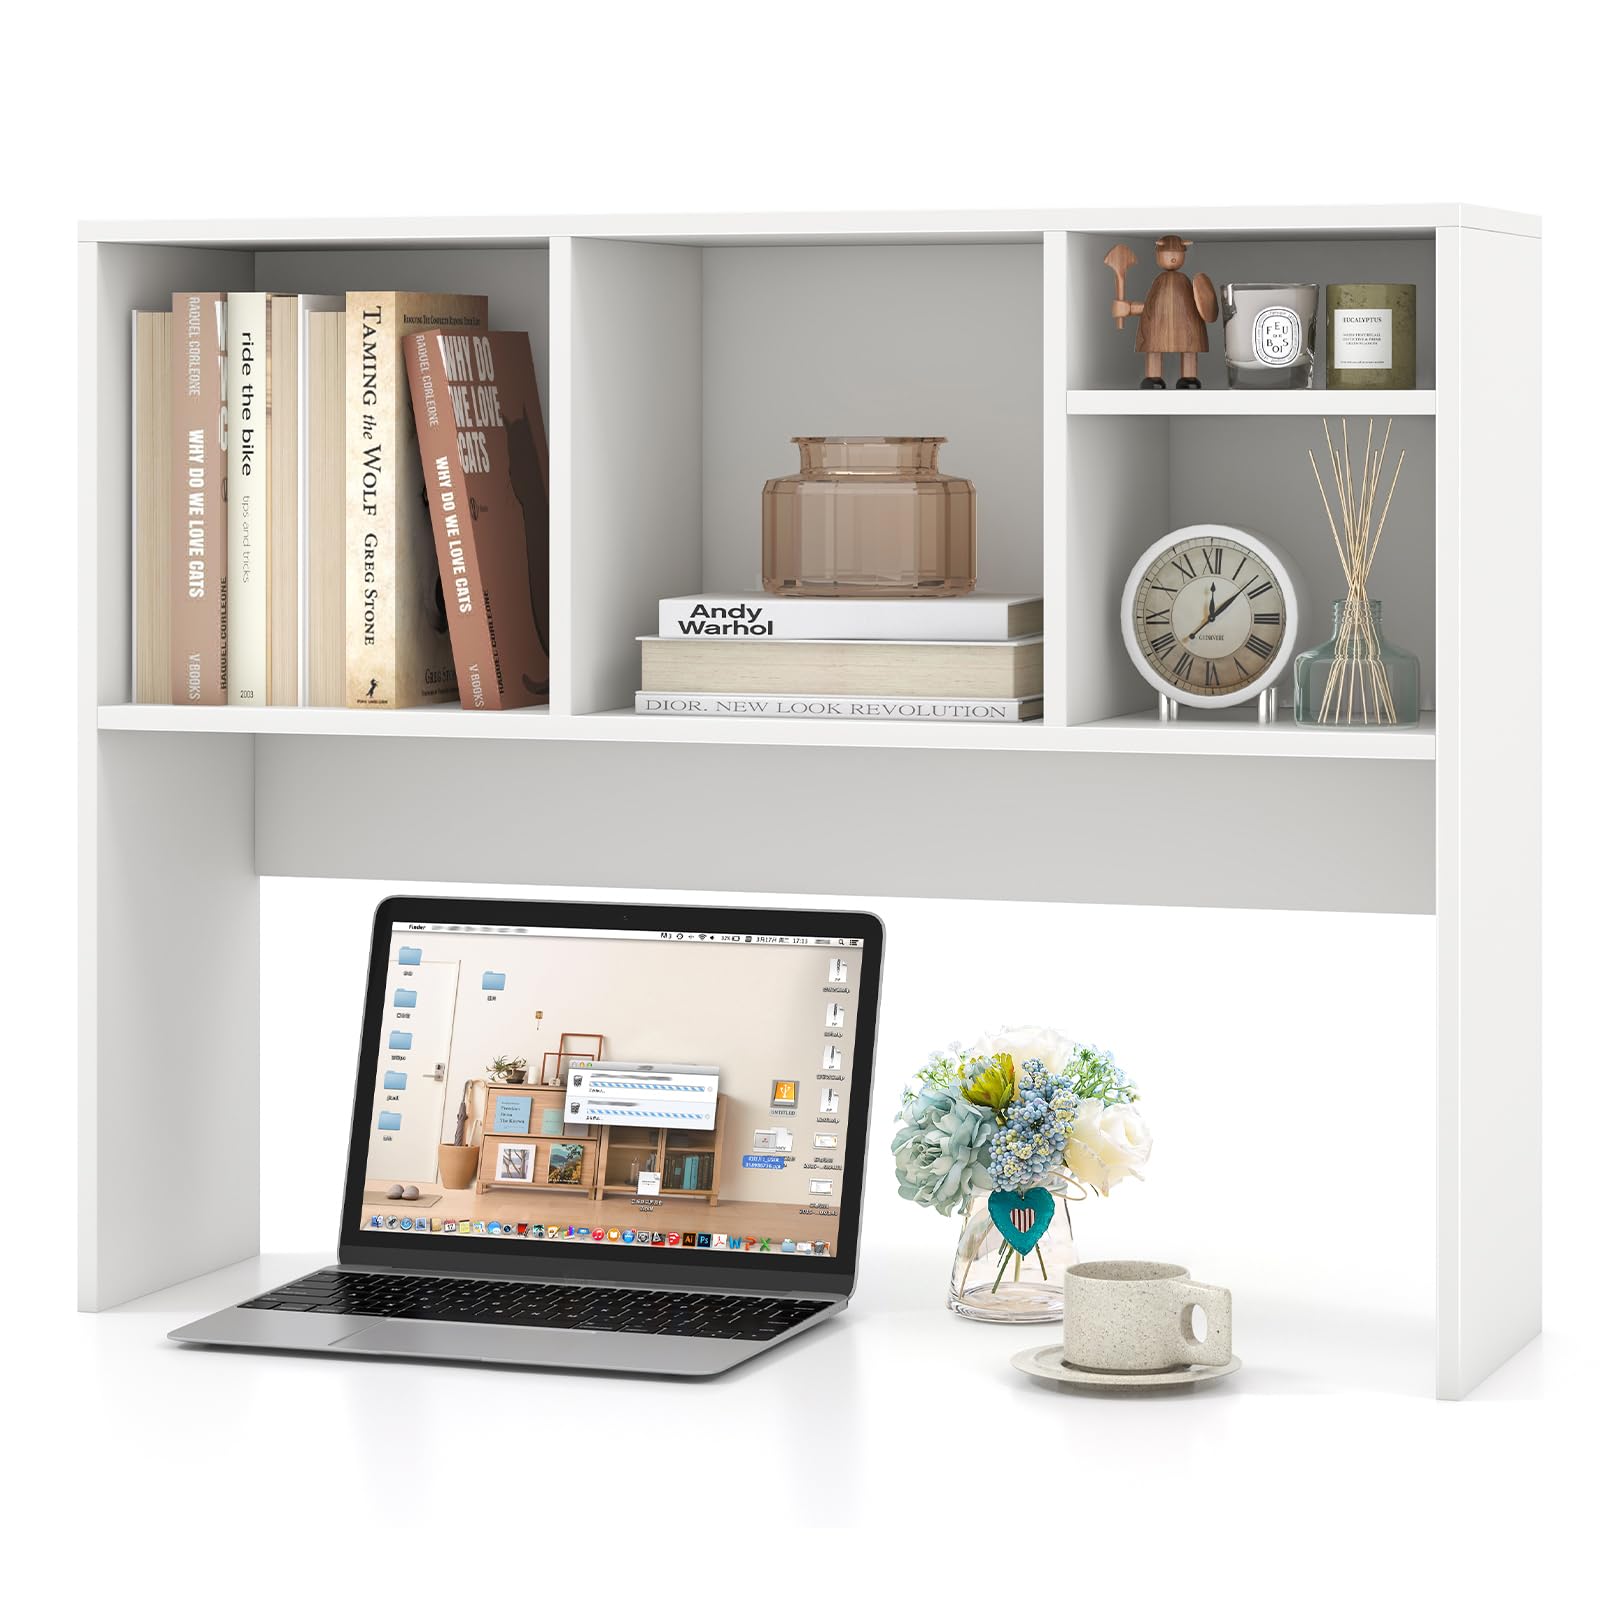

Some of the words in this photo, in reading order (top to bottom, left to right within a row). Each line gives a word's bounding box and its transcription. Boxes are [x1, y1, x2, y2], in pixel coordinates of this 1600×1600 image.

[241, 332, 254, 376] ride
[362, 305, 382, 406] TAMING
[437, 335, 473, 381] WHY
[473, 336, 495, 382] DO
[241, 384, 254, 421] the
[448, 385, 473, 428] WE
[470, 385, 504, 427] LOVE
[362, 414, 377, 440] the
[188, 429, 204, 463] WHY
[241, 429, 254, 476] bike
[457, 431, 490, 474] CATS
[188, 468, 204, 488] DO
[362, 444, 382, 516] WOLF
[435, 456, 452, 488] WHY
[188, 493, 204, 516] WE
[241, 495, 251, 518] tips
[441, 492, 456, 511] DO
[188, 520, 204, 556] LOVE
[242, 521, 251, 547] and
[444, 514, 460, 538] WE
[242, 551, 251, 583] tricks
[364, 533, 378, 584] GREG
[449, 540, 466, 575] LOVE
[188, 561, 204, 598] CATS
[455, 577, 472, 614] CATS
[364, 588, 378, 646] STONE
[678, 620, 773, 636] Warhol
[689, 603, 762, 622] Andy
[240, 690, 254, 698] 2003
[646, 699, 708, 712] DIOR.
[716, 700, 768, 713] NEW
[777, 702, 841, 715] LOOK
[850, 702, 1007, 718] REVOLUTION
[685, 1235, 694, 1243] Ai
[700, 1235, 709, 1244] Ps
